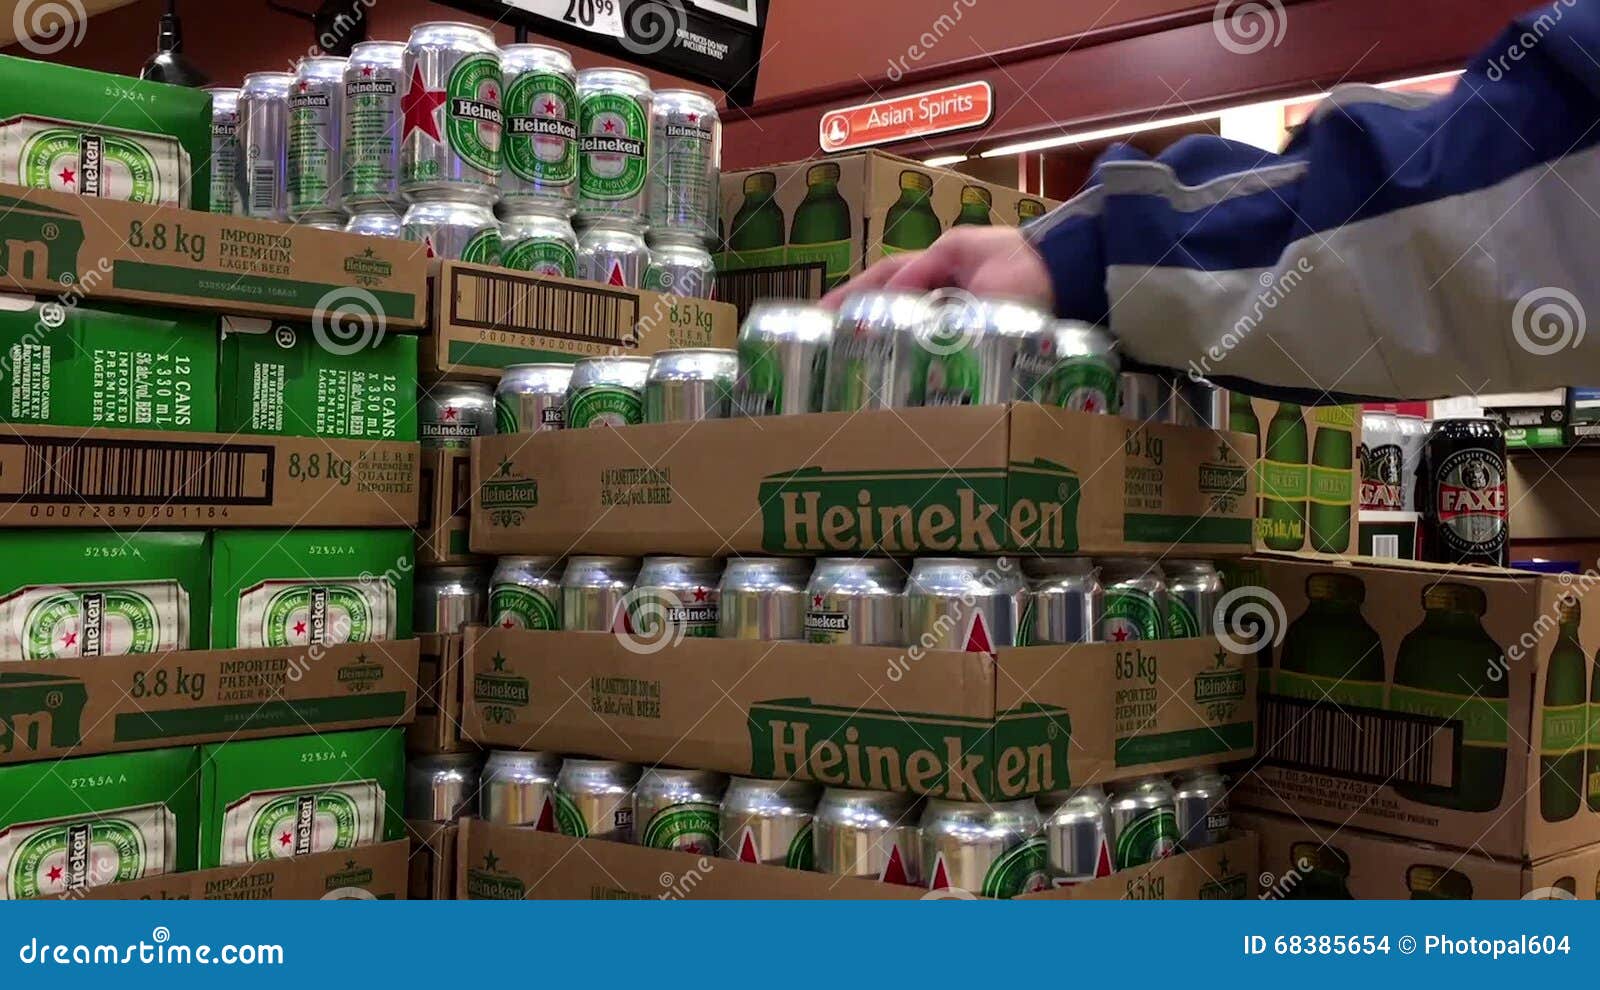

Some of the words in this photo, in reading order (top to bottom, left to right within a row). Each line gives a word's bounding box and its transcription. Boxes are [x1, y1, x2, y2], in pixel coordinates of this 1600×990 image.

[683, 39, 707, 54] INCLUDE
[708, 48, 723, 60] TAXES
[690, 32, 706, 45] PRICES
[707, 38, 716, 48] DO
[716, 42, 728, 53] NOT
[866, 108, 913, 129] Asian
[919, 94, 973, 123] Spirits
[513, 118, 577, 138] Heineken
[667, 127, 712, 140] Heineken
[81, 141, 99, 196] ineken
[129, 220, 166, 250] 8.8
[175, 224, 206, 262] kg
[221, 228, 292, 249] IMPORTED
[219, 258, 257, 273] LAGER
[261, 261, 291, 275] BEER
[220, 243, 291, 263] PREMIUM
[696, 305, 712, 333] kg
[32, 345, 41, 357] BY
[42, 346, 51, 374] BREWED
[94, 350, 103, 387] LAGER
[175, 356, 191, 375] 12
[269, 364, 277, 376] BY
[31, 363, 41, 419] HEINEKEN
[42, 376, 50, 390] AND
[106, 351, 116, 422] PREMIUM
[118, 352, 128, 423] IMPORTED
[157, 369, 172, 396] 330
[318, 369, 327, 403] LAGER
[383, 376, 396, 391] 12
[93, 391, 103, 421] BEER
[175, 381, 191, 425] CANS
[267, 382, 275, 430] HEINEKEN
[327, 370, 337, 434] PREMIUM
[336, 370, 346, 434] IMPORTED
[368, 386, 381, 411] 330
[135, 402, 151, 424] BEER
[156, 403, 172, 424] mL
[316, 406, 326, 433] BEER
[382, 398, 396, 437] CANS
[423, 425, 477, 436] Heineken
[289, 453, 320, 482] 8,8
[326, 453, 352, 486] kg
[482, 486, 535, 502] Heineken
[1442, 490, 1505, 511] FAXE
[781, 489, 1065, 552] Heineken
[84, 598, 100, 657] ineken
[310, 591, 325, 646] ineken
[219, 672, 287, 689] PREMIUM
[220, 659, 288, 675] IMPORTED
[1136, 649, 1157, 685] kg
[130, 670, 168, 699] 8.8
[176, 667, 206, 700] kg
[218, 687, 251, 700] LAGER
[476, 680, 526, 699] Heineken
[768, 719, 1055, 800] Heineken
[296, 800, 312, 855] ineken
[69, 831, 87, 890] ineken
[205, 873, 275, 894] IMPORTED
